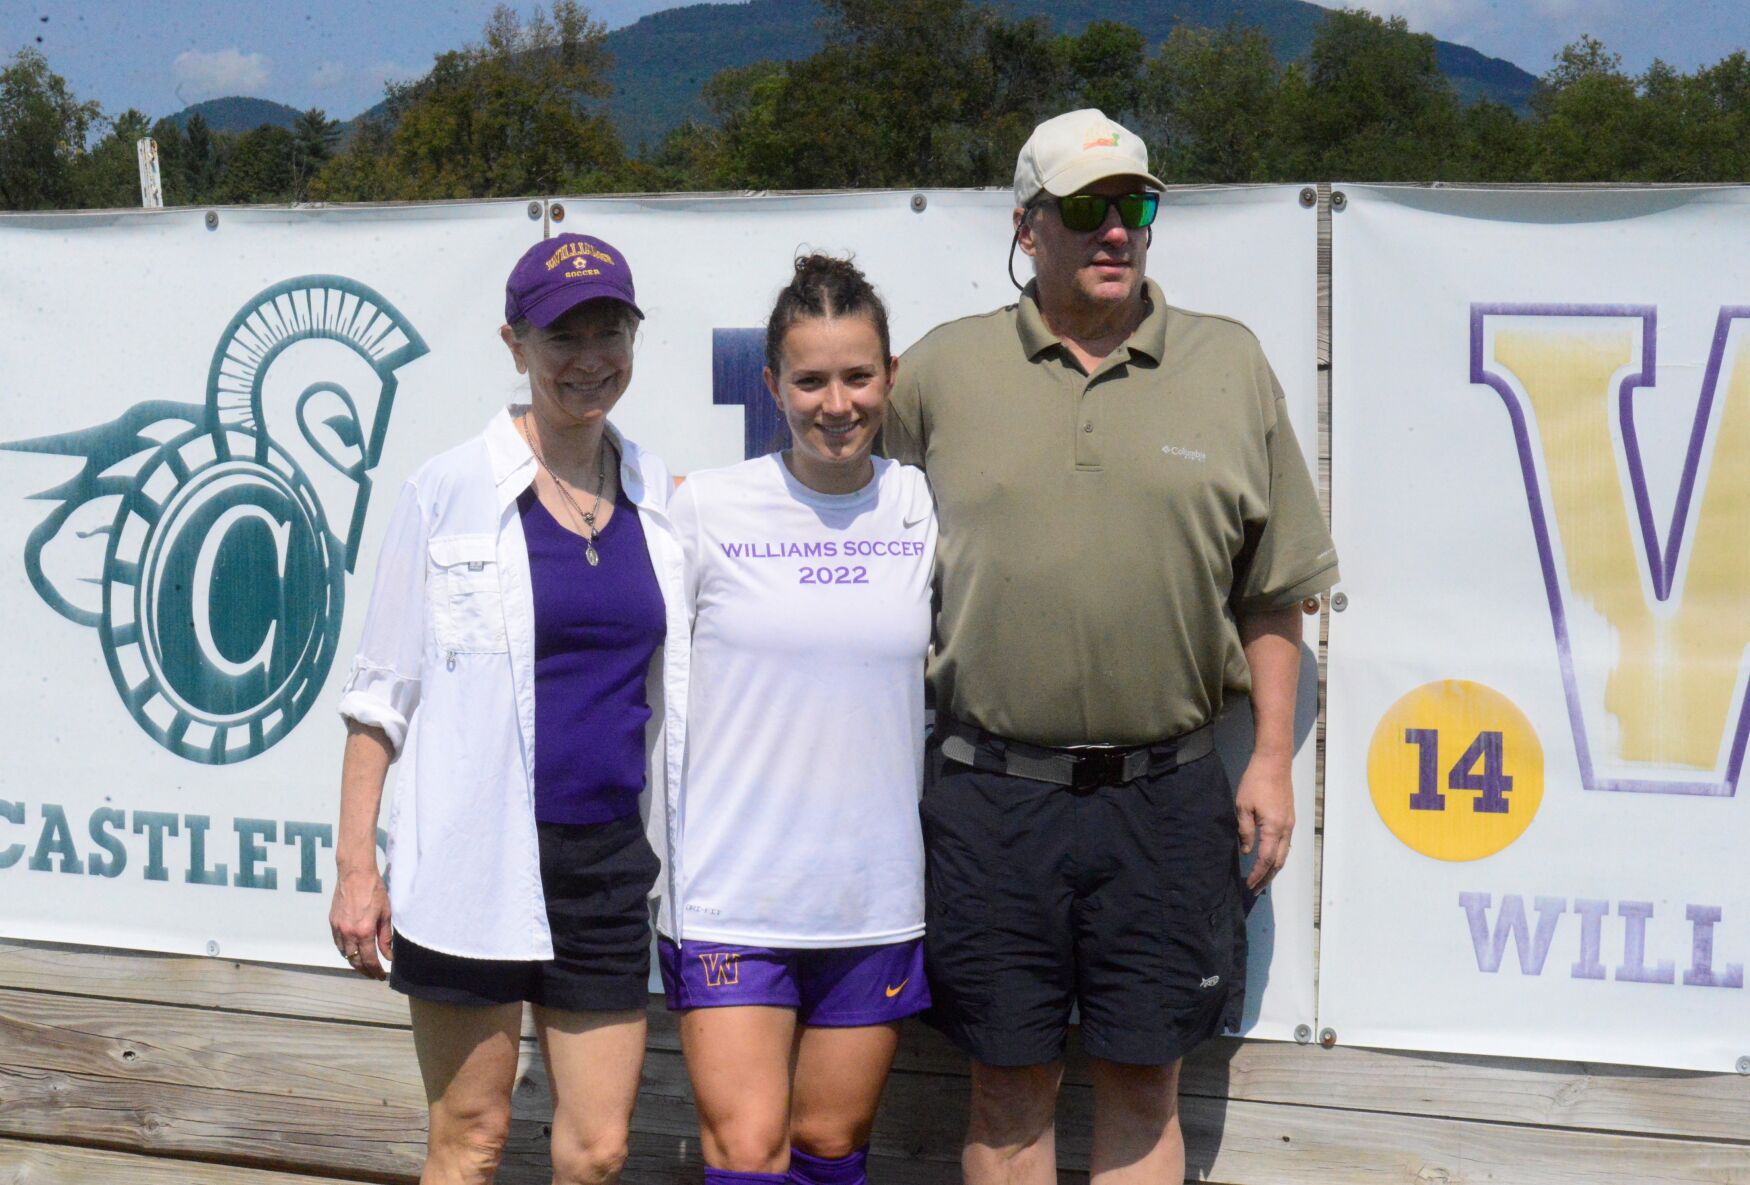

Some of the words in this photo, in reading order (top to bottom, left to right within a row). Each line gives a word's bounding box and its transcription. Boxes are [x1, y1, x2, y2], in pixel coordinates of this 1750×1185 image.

[720, 542, 838, 558] WILLIAMS
[843, 541, 925, 556] SOCCER
[799, 566, 869, 584] 2022
[1405, 728, 1513, 814] 14
[0, 800, 390, 893] CASTLET
[699, 952, 739, 987] W
[1459, 891, 1744, 988] WILL
